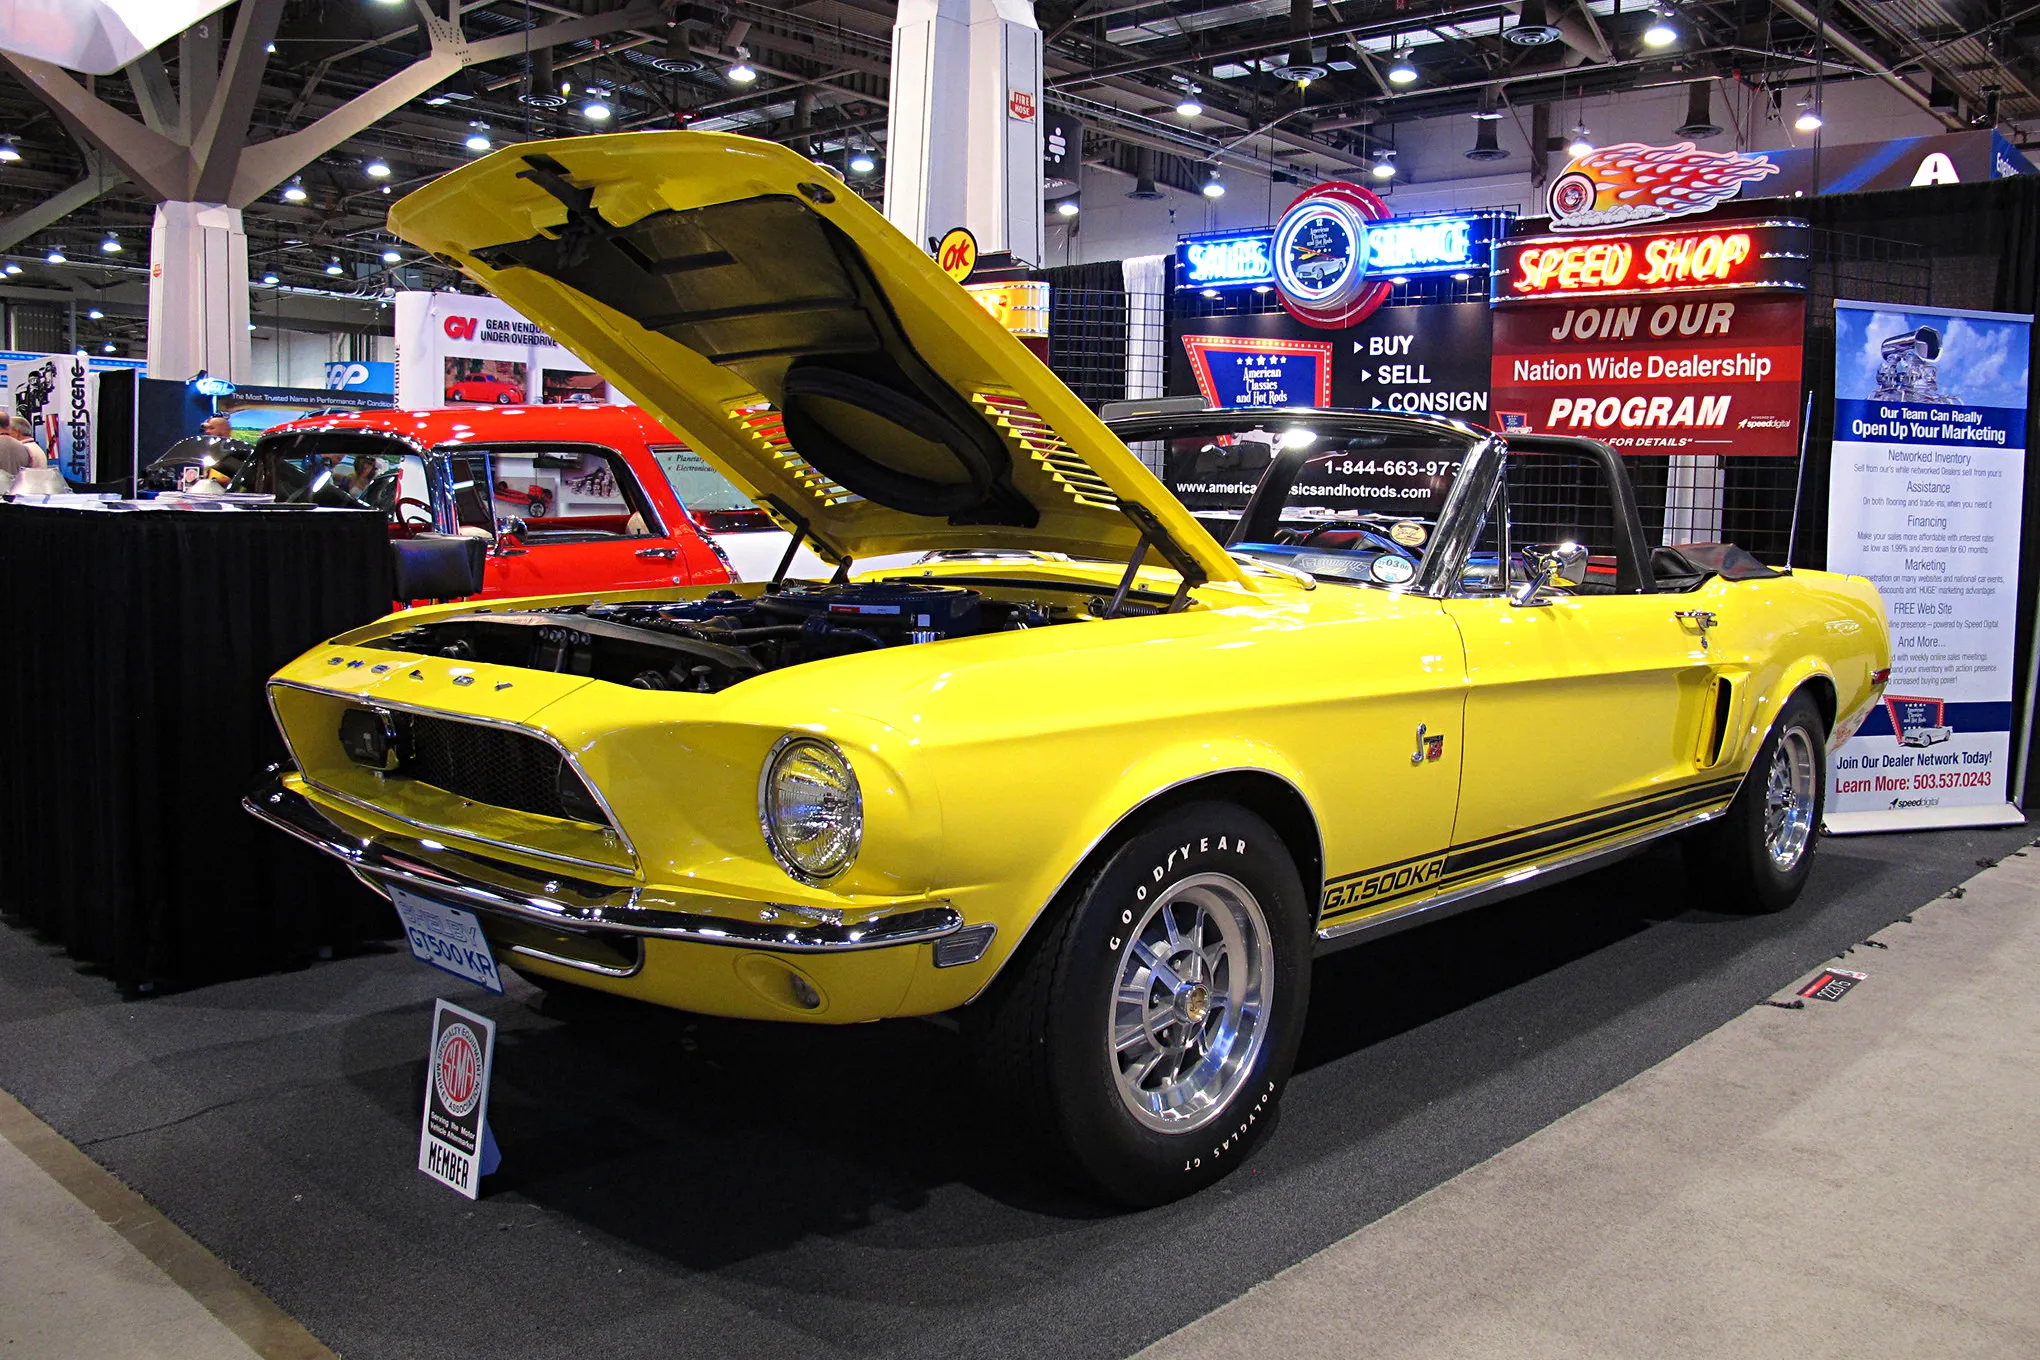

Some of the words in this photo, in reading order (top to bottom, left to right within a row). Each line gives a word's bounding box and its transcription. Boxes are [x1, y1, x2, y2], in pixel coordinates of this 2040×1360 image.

[1015, 93, 1031, 106] FIRE
[1014, 104, 1031, 115] HOSE
[943, 239, 970, 272] OK
[1513, 242, 1633, 291] SPEED
[1638, 233, 1751, 284] SHOP
[444, 315, 478, 340] GV
[486, 319, 510, 332] GEAR
[512, 322, 546, 334] VENDO
[1551, 306, 1642, 341] JOIN
[1650, 302, 1735, 338] OUR
[481, 331, 510, 344] UNDER
[512, 334, 558, 347] OVERDRIVE
[1369, 336, 1414, 356] BUY
[1243, 367, 1282, 382] American
[1377, 365, 1431, 385] SELL
[1513, 360, 1581, 382] Nation
[1586, 355, 1643, 380] Wide
[1646, 353, 1772, 382] Dealership
[1246, 379, 1278, 393] Classics
[264, 394, 288, 402] Trusted
[317, 397, 356, 405] Performance
[1236, 394, 1252, 404] and
[1253, 391, 1267, 404] Hot
[1269, 391, 1288, 403] Rods
[1387, 392, 1488, 412] CONSIGN
[67, 358, 90, 481] streetscene
[1547, 395, 1731, 429] PROGRAM
[1880, 406, 1899, 419] Our
[1901, 408, 1928, 421] Team
[1930, 409, 1949, 421] Can
[1952, 410, 1982, 425] Really
[1747, 419, 1791, 429] speeddigital
[1852, 419, 1887, 438] Open
[1890, 421, 1908, 440] Up
[1910, 422, 1939, 438] Your
[1942, 425, 2006, 444] Marketing
[1608, 438, 1634, 446] FOR
[1888, 449, 1932, 463] Networked
[1935, 451, 1971, 466] Inventory
[1324, 461, 1463, 477] 1-844-663-973
[1854, 464, 1865, 472] Sell
[1866, 465, 1878, 473] from
[1879, 465, 1894, 473] our's
[1895, 466, 1910, 474] while
[1911, 467, 1940, 475] networked
[1941, 467, 1961, 476] Dealers
[1962, 468, 1973, 476] sell
[1974, 469, 1987, 477] from
[1906, 481, 1951, 493] Assistance
[1862, 496, 1871, 505] On
[1871, 497, 1884, 506] both
[1885, 497, 1907, 507] flooring
[1908, 499, 1918, 507] and
[1947, 500, 1961, 508] when
[1962, 502, 1973, 510] you
[1974, 501, 1987, 509] need
[1907, 515, 1947, 529] Financing
[1857, 531, 1872, 540] Make
[1873, 533, 1886, 541] your
[1887, 532, 1902, 540] sales
[1919, 533, 1946, 541] affordable
[1947, 534, 1958, 542] with
[1959, 534, 1980, 542] interest
[1870, 544, 1880, 552] low
[1891, 544, 1908, 553] 1.99%
[1909, 545, 1920, 553] and
[1935, 545, 1949, 553] down
[1949, 545, 1957, 553] for
[1957, 545, 1967, 553] 60
[1904, 558, 1946, 573] Marketing
[1901, 576, 1916, 584] many
[1918, 575, 1942, 583] websites
[1943, 575, 1953, 583] and
[1954, 575, 1977, 583] national
[1905, 586, 1916, 594] and
[1939, 586, 1964, 596] marketing
[1894, 602, 1916, 614] FREE
[1917, 602, 1936, 615] Web
[1937, 602, 1953, 615] Site
[1900, 621, 1927, 630] presence
[1933, 620, 1956, 630] powered
[1956, 620, 1963, 629] by
[1964, 620, 1983, 630] Speed
[1898, 636, 1915, 647] And
[1917, 636, 1946, 648] More...
[1910, 653, 1929, 662] weekly
[1904, 666, 1917, 674] your
[1918, 665, 1943, 674] inventory
[1893, 677, 1919, 685] increased
[1921, 676, 1939, 686] buying
[1940, 676, 1958, 685] power!
[1836, 756, 1858, 770] Join
[1862, 755, 1880, 769] Our
[1882, 753, 1914, 768] Dealer
[1917, 752, 1959, 767] Network
[1962, 751, 1993, 766] Today!
[1835, 777, 1871, 794] Learn
[1875, 775, 1910, 791] More:
[1913, 771, 1992, 790] 503.537.0243
[1109, 836, 1246, 950] GOODYEAR
[409, 926, 463, 966] GT500
[463, 948, 494, 979] KR
[438, 1028, 461, 1059] SPECIALTY
[461, 1028, 481, 1077] EQUIPMENT
[443, 1040, 475, 1099] SEMA
[448, 1081, 480, 1114] ASSOCIATION
[431, 1111, 449, 1128] Serving
[450, 1122, 459, 1132] the
[460, 1126, 476, 1140] Motor
[1214, 1081, 1275, 1158] POLYGLAS
[430, 1121, 447, 1136] Vehicle
[447, 1130, 475, 1151] Aftermarket
[428, 1140, 469, 1189] MEMBER
